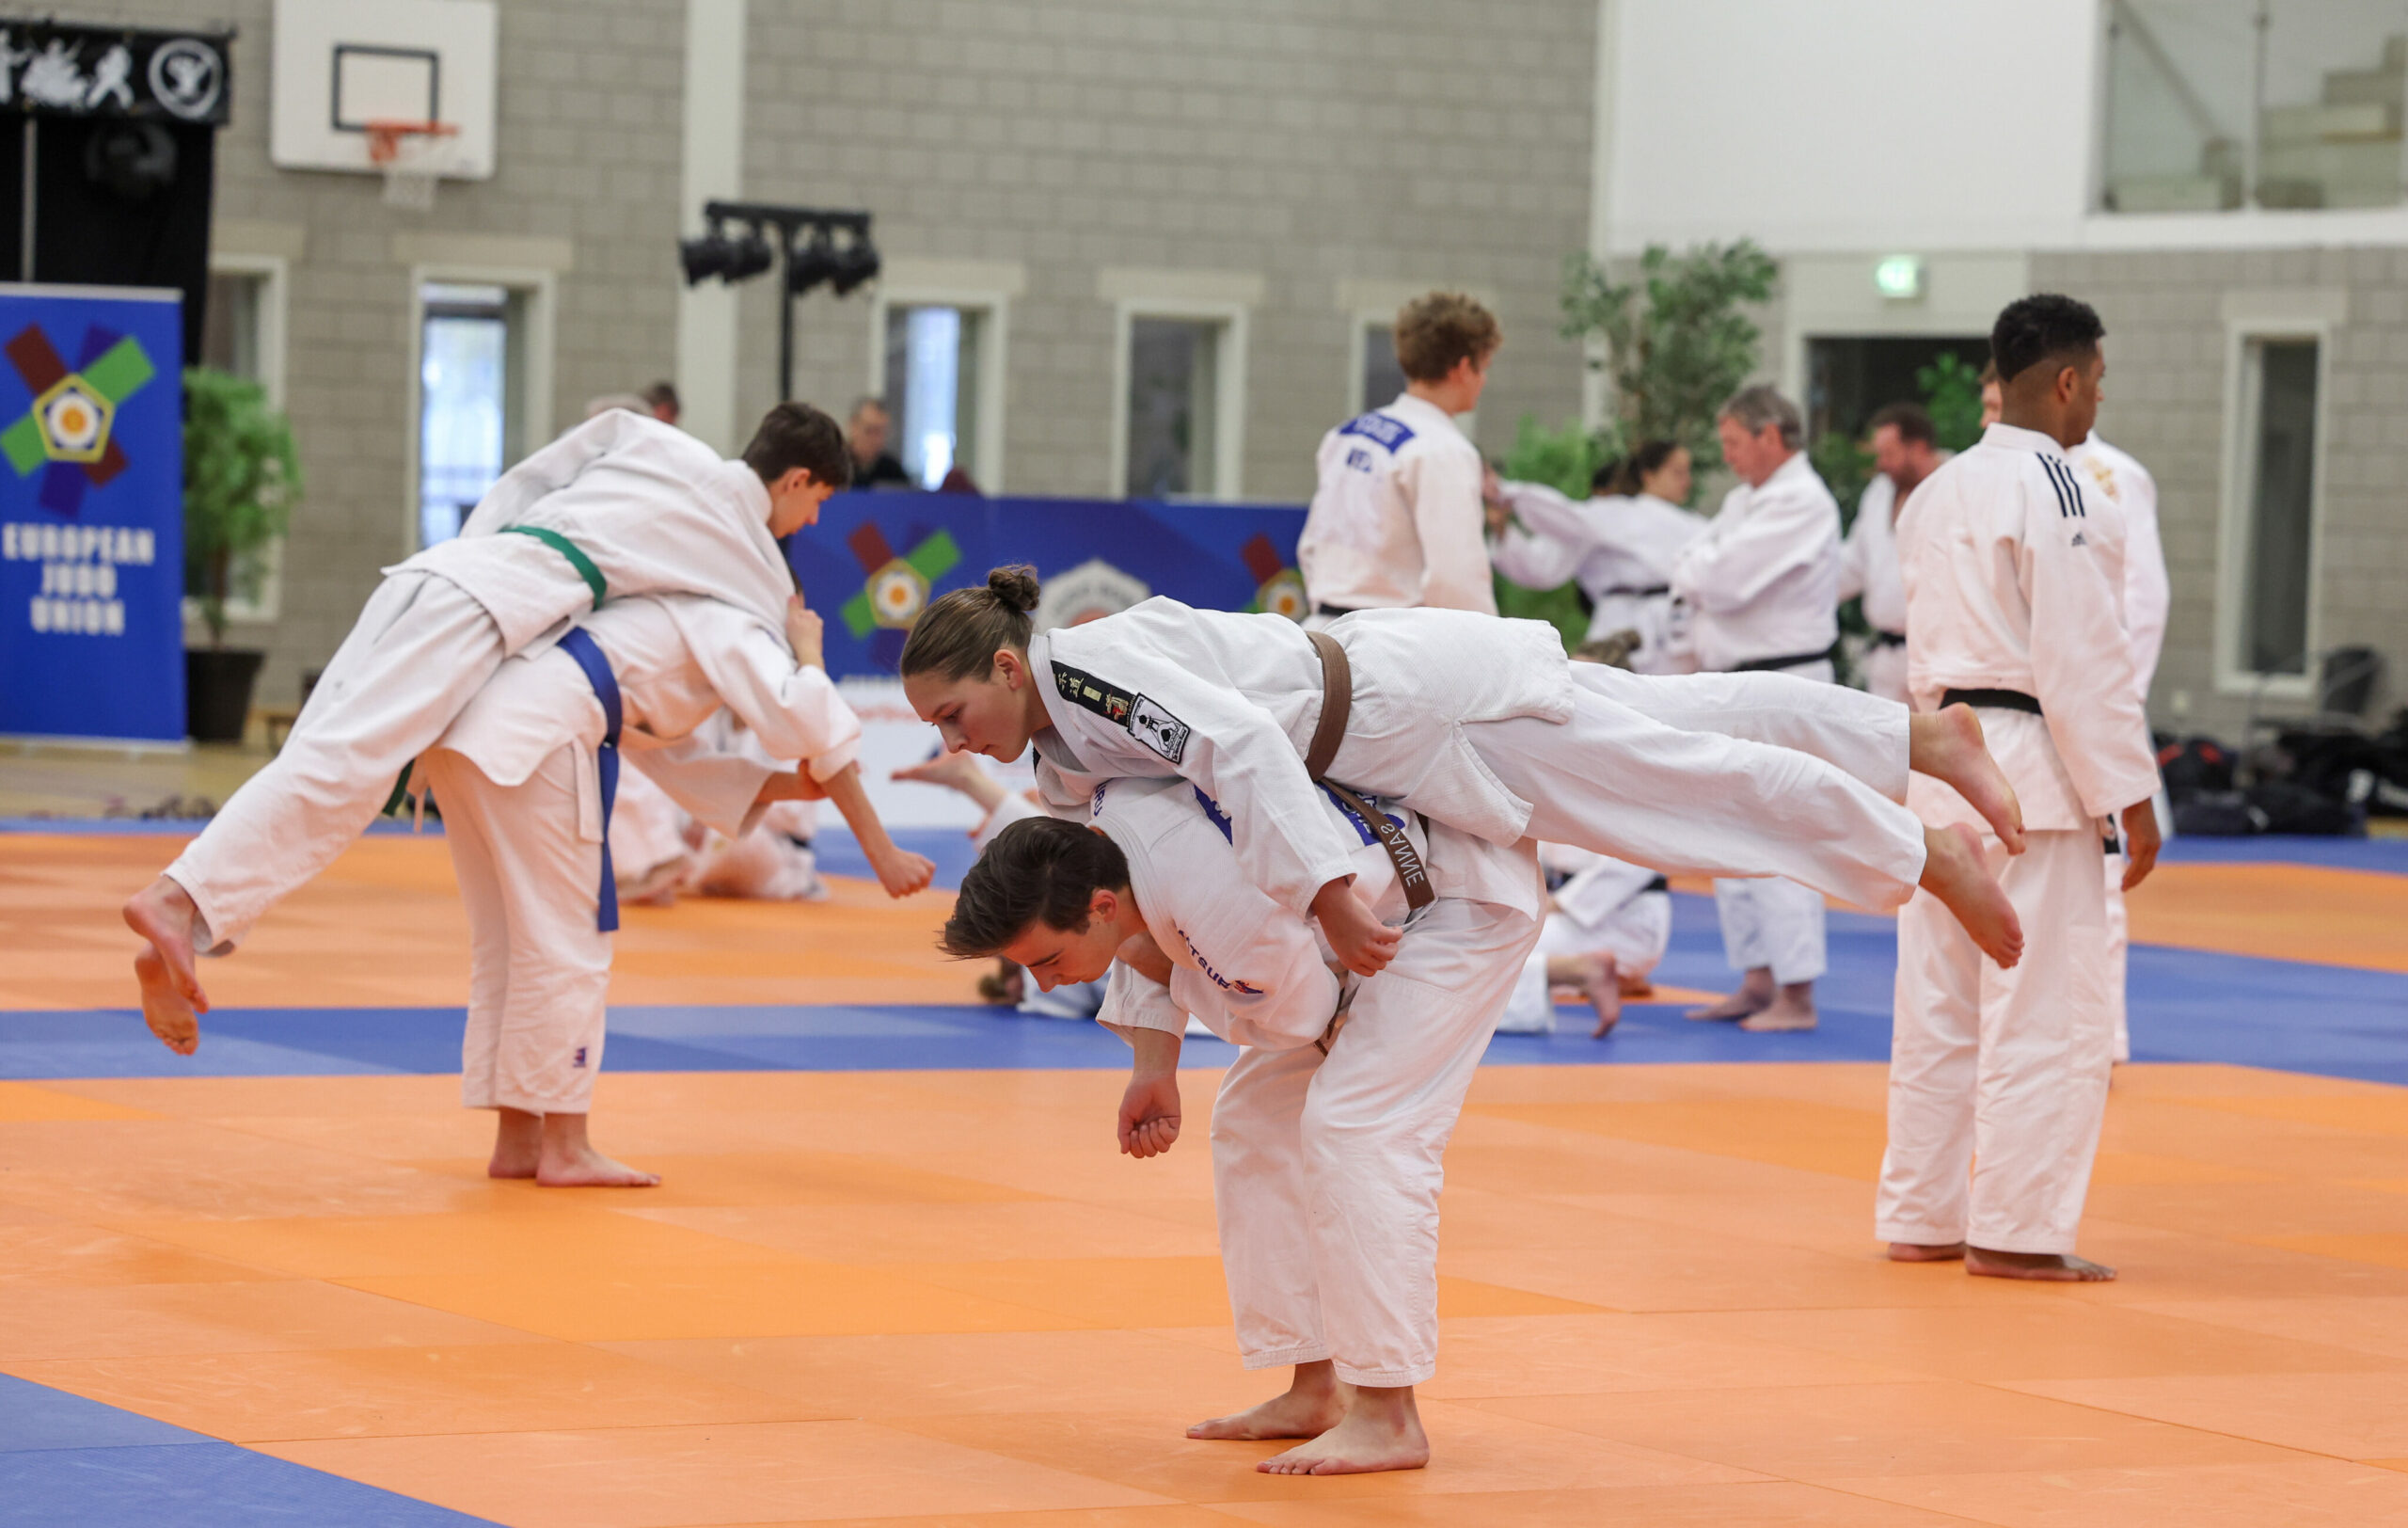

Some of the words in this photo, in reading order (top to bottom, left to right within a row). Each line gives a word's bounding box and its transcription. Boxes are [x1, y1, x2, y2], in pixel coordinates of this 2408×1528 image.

[2, 523, 155, 565] EUROPEAN
[41, 562, 118, 597] JUDO
[30, 596, 126, 635] UNION
